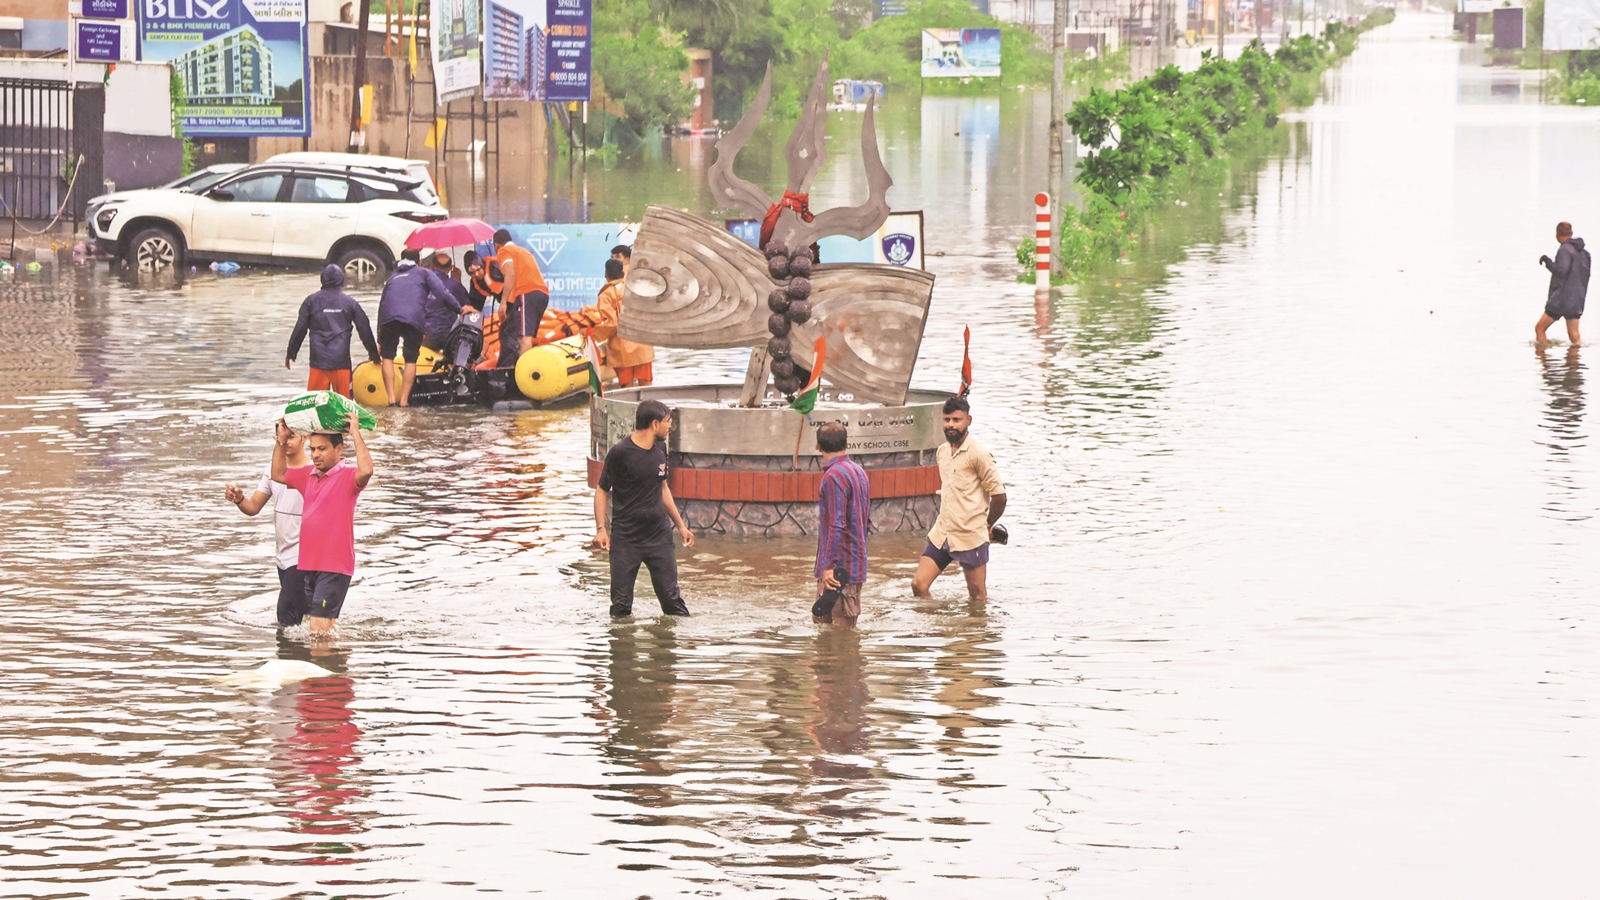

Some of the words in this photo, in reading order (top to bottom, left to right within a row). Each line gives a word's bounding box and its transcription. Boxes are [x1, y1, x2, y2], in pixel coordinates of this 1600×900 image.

[184, 22, 212, 30] PREMIUM
[213, 22, 231, 30] FLATS
[551, 25, 571, 36] COMING
[572, 25, 587, 36] SOON
[555, 72, 567, 81] 8000
[216, 117, 231, 125] Petrol
[565, 277, 584, 291] TMT
[863, 440, 892, 449] SCHOOL
